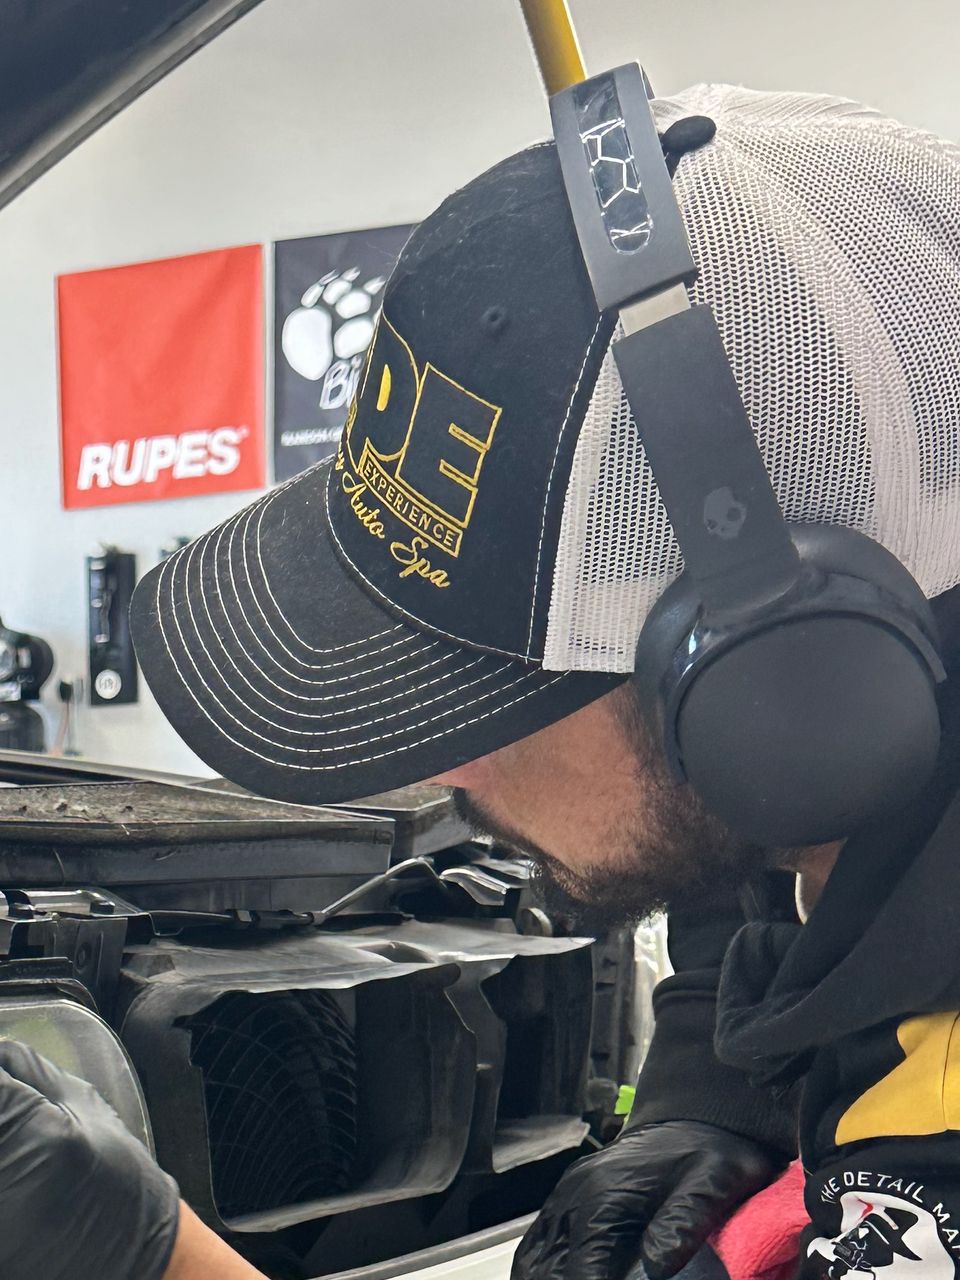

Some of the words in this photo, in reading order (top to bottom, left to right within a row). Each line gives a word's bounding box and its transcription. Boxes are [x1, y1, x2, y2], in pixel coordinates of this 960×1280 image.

[320, 354, 361, 410] Bi
[77, 427, 241, 491] RUPES
[342, 471, 386, 539] Auto
[390, 536, 451, 588] Spa
[363, 459, 456, 548] EXPERIENCE
[820, 1177, 841, 1205] THE
[843, 1171, 926, 1204] DETAIL
